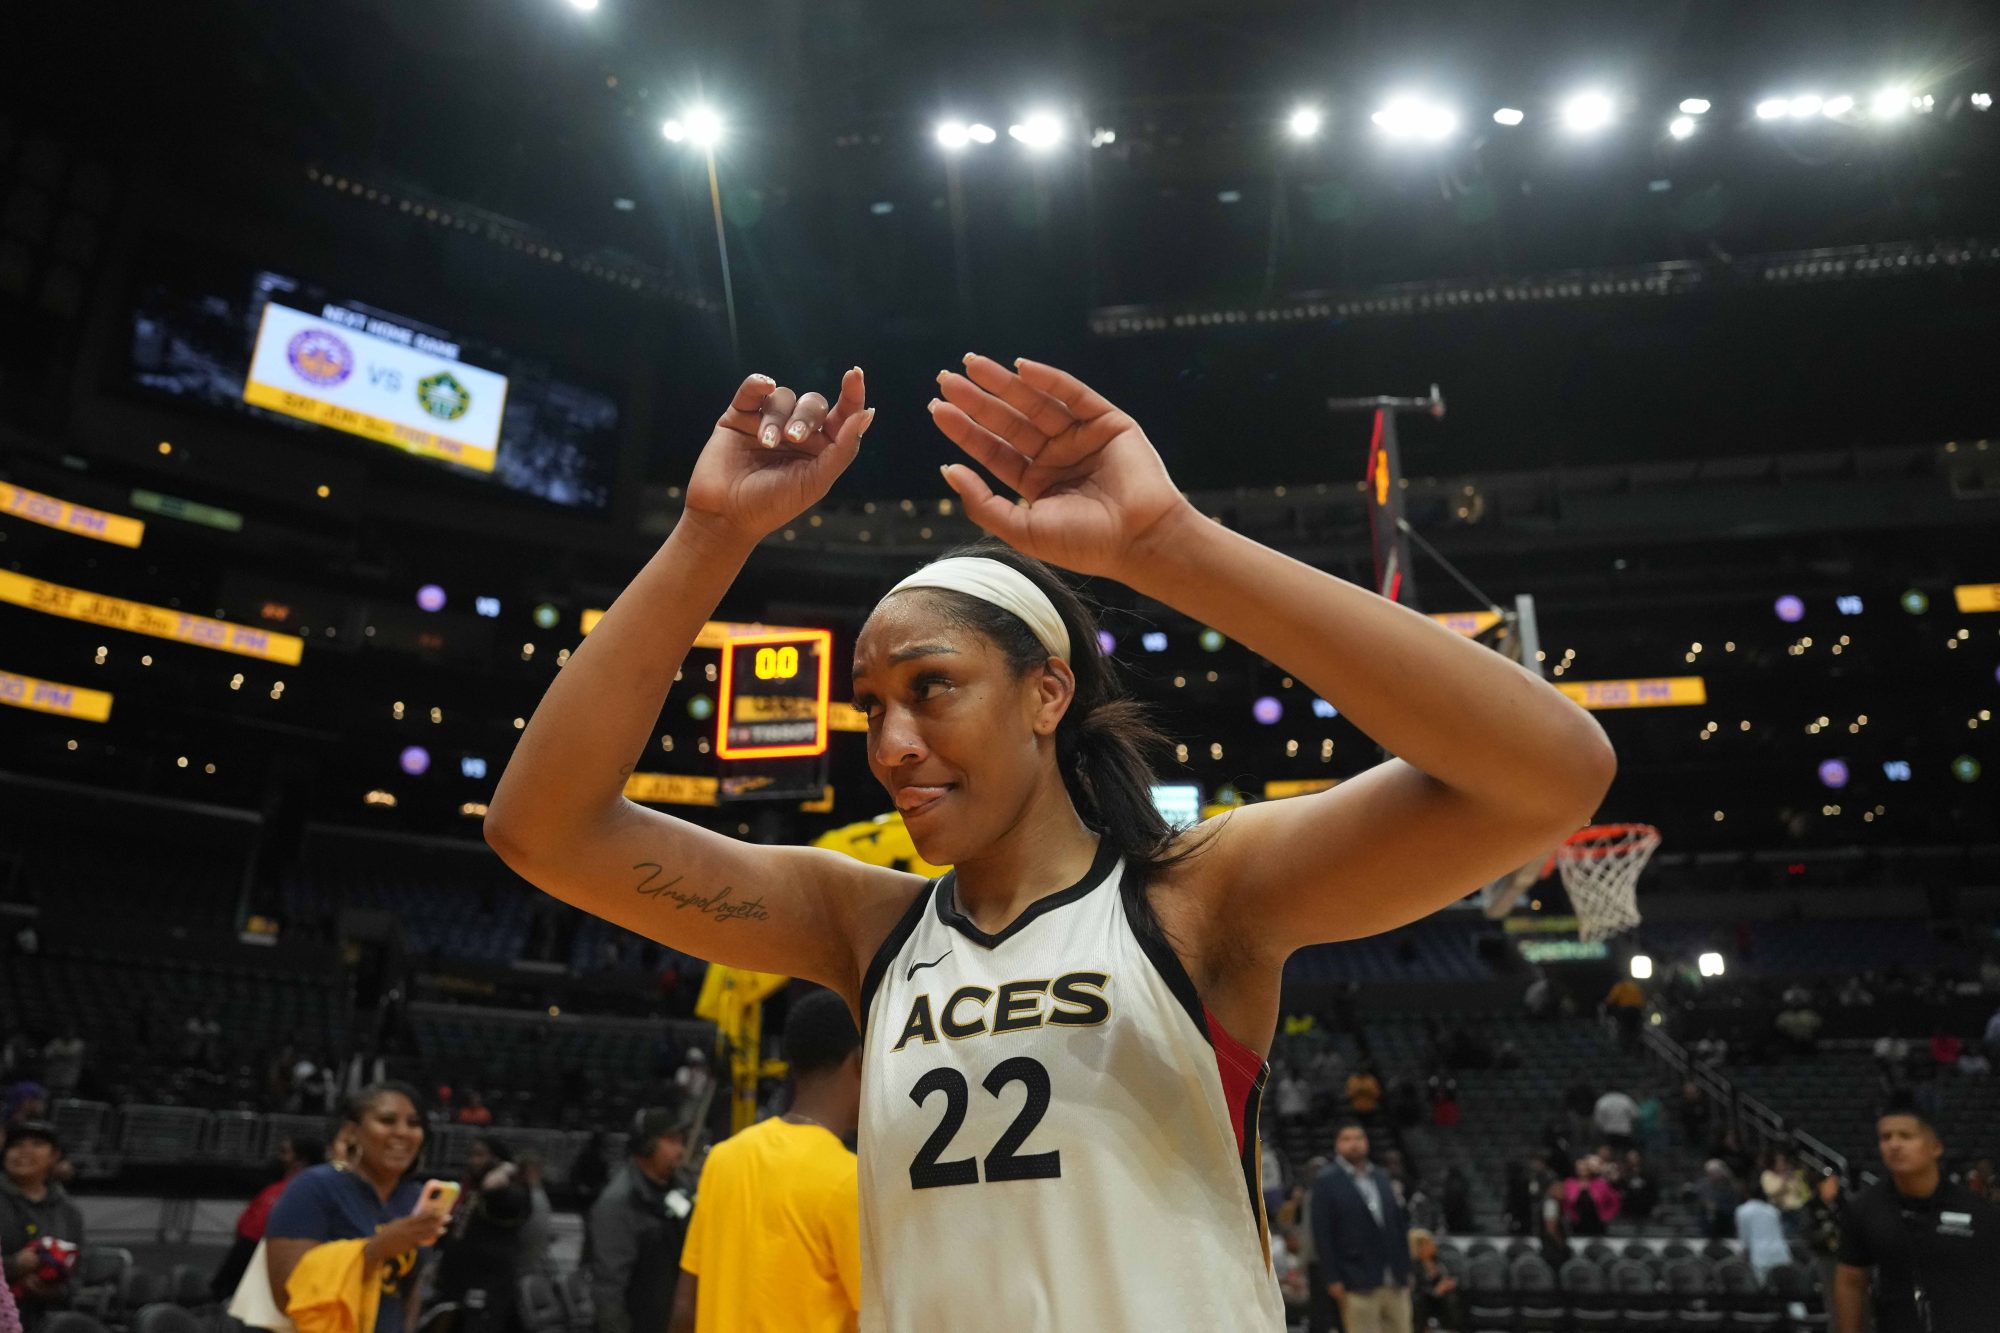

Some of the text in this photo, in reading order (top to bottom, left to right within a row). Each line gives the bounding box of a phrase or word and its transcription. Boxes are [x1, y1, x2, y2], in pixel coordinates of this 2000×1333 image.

[367, 362, 400, 393] VS
[68, 503, 107, 534] PM
[31, 581, 74, 611] SAT
[81, 598, 129, 624] JUN
[232, 627, 269, 652] PM
[34, 681, 73, 710] PM
[632, 862, 770, 922] Unapologetic
[890, 971, 1112, 1053] ACES
[908, 1056, 1062, 1190] 22
